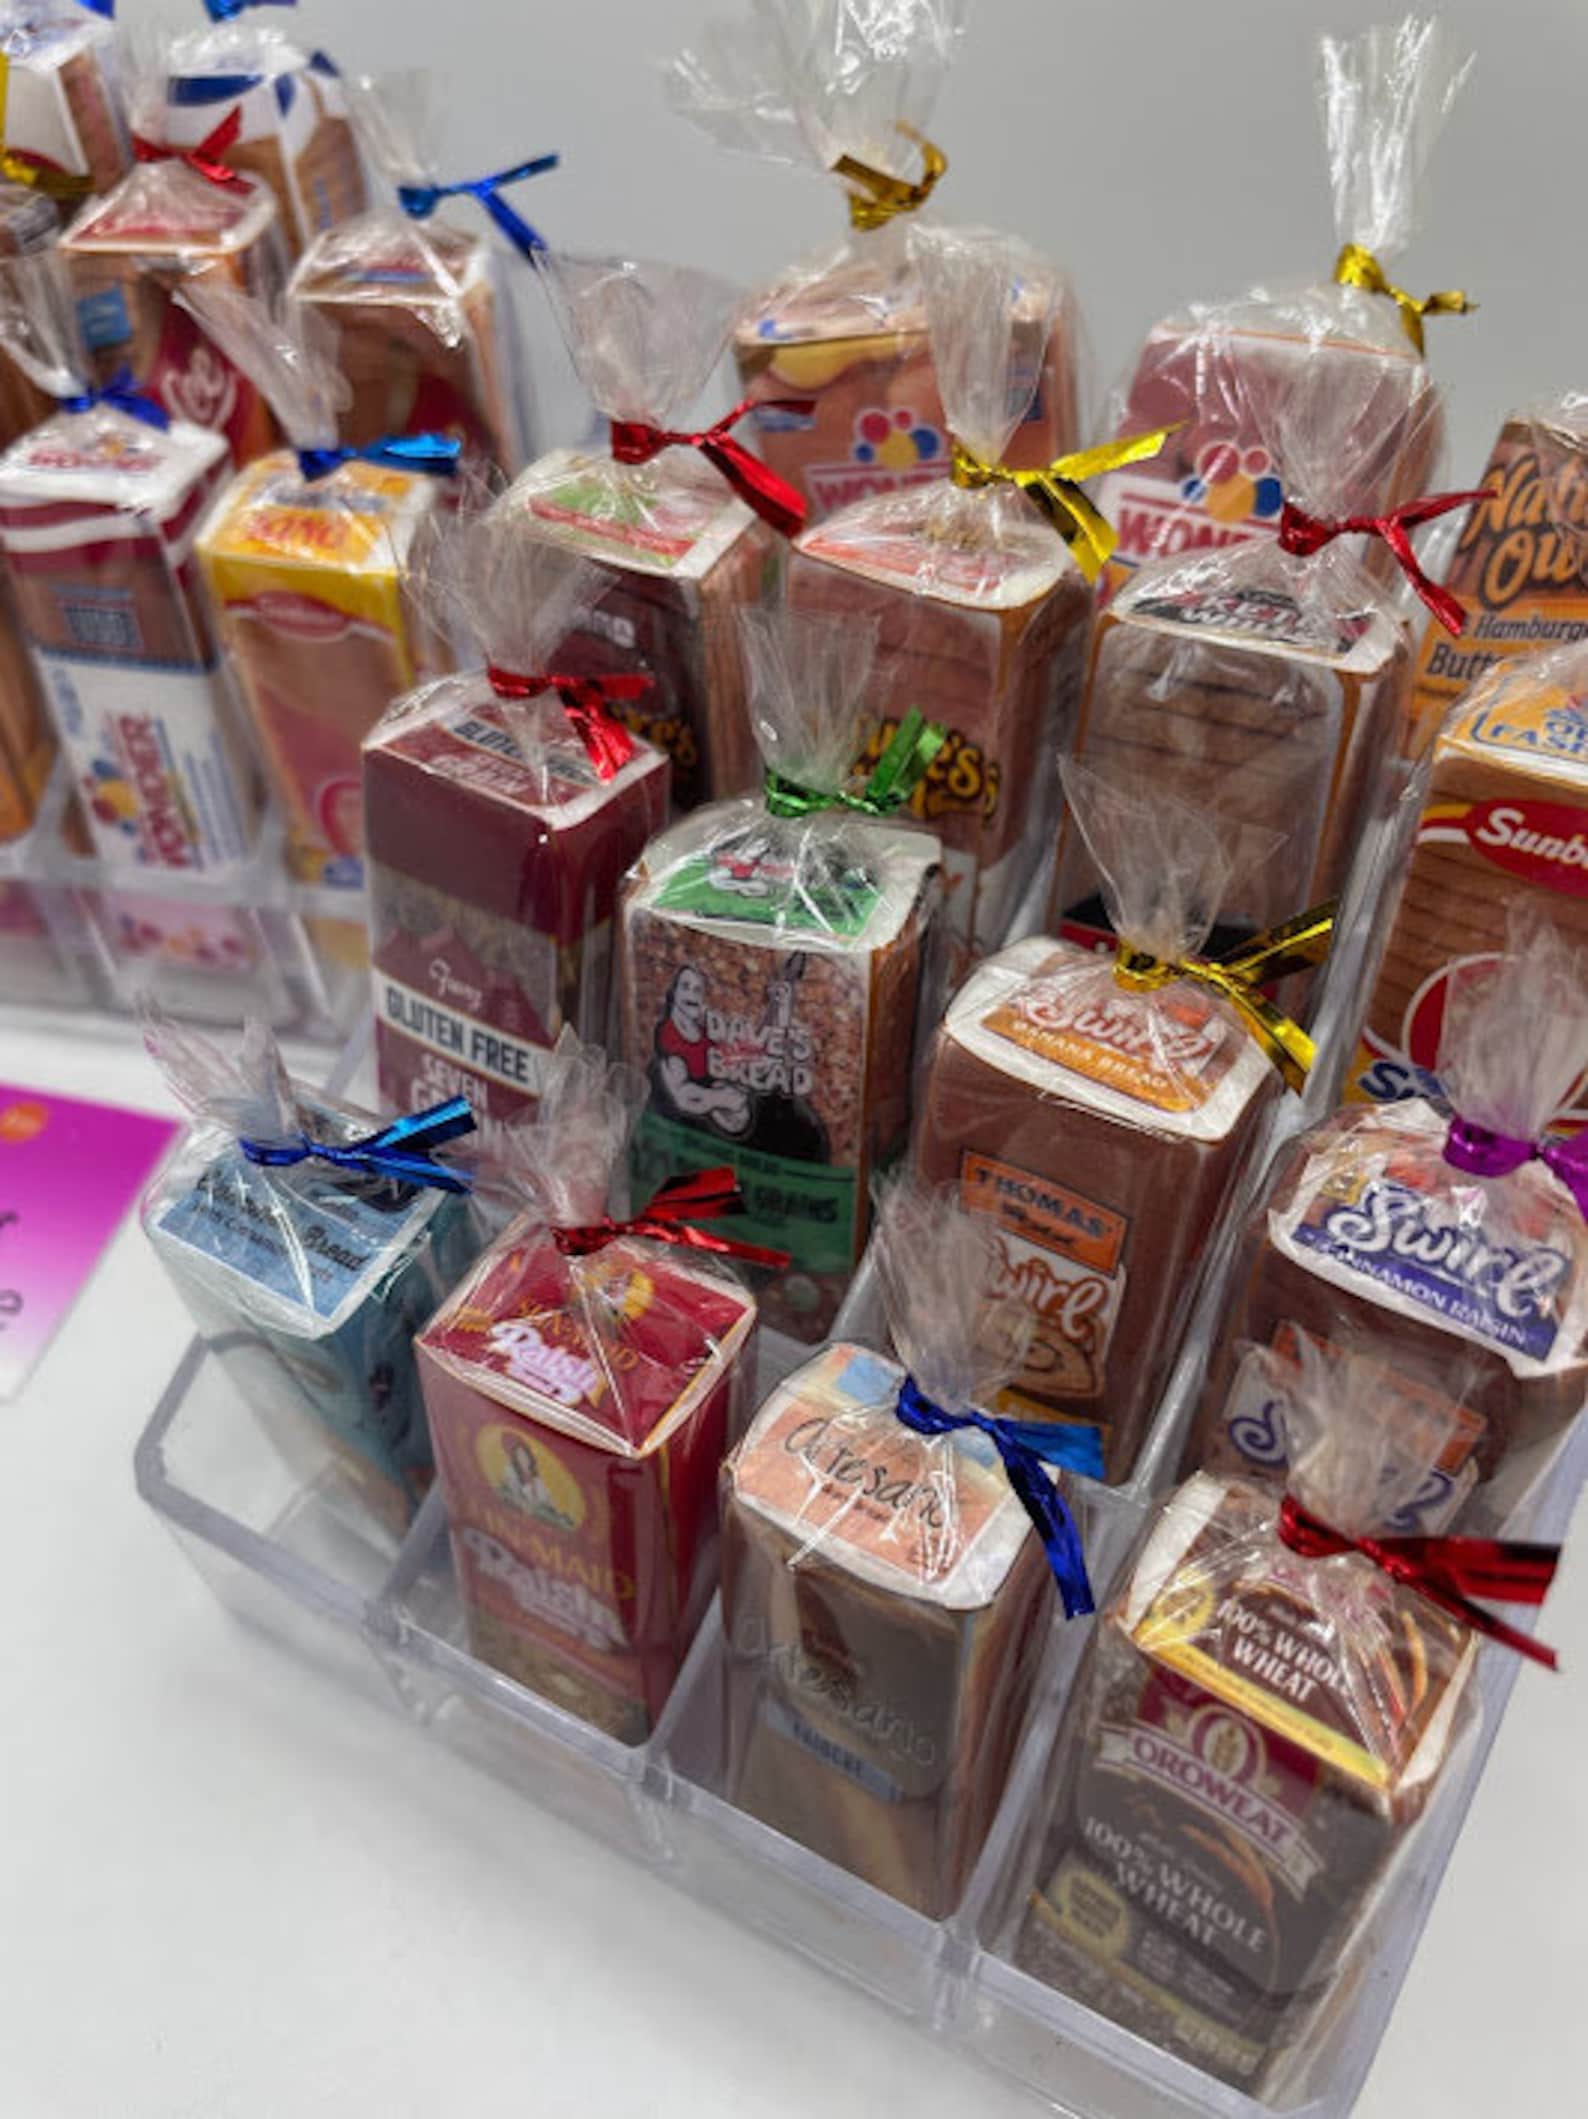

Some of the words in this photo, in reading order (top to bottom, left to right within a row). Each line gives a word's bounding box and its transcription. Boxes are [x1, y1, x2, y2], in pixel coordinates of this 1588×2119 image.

[1426, 643, 1503, 681] Butt
[1475, 808, 1588, 869] Sunb
[385, 985, 464, 1057] GLUTEN
[470, 1028, 530, 1085] FREE
[1324, 1184, 1572, 1320] Swirl
[1449, 1300, 1529, 1346] RAISIN
[1216, 1598, 1273, 1646] 100%
[1232, 1635, 1319, 1704] WHEAT
[1132, 1735, 1291, 1846] OROWEAT
[1083, 1815, 1154, 1874] 100%
[1159, 1862, 1268, 1954] WHOLE
[1114, 1860, 1219, 1947] WHEAT
